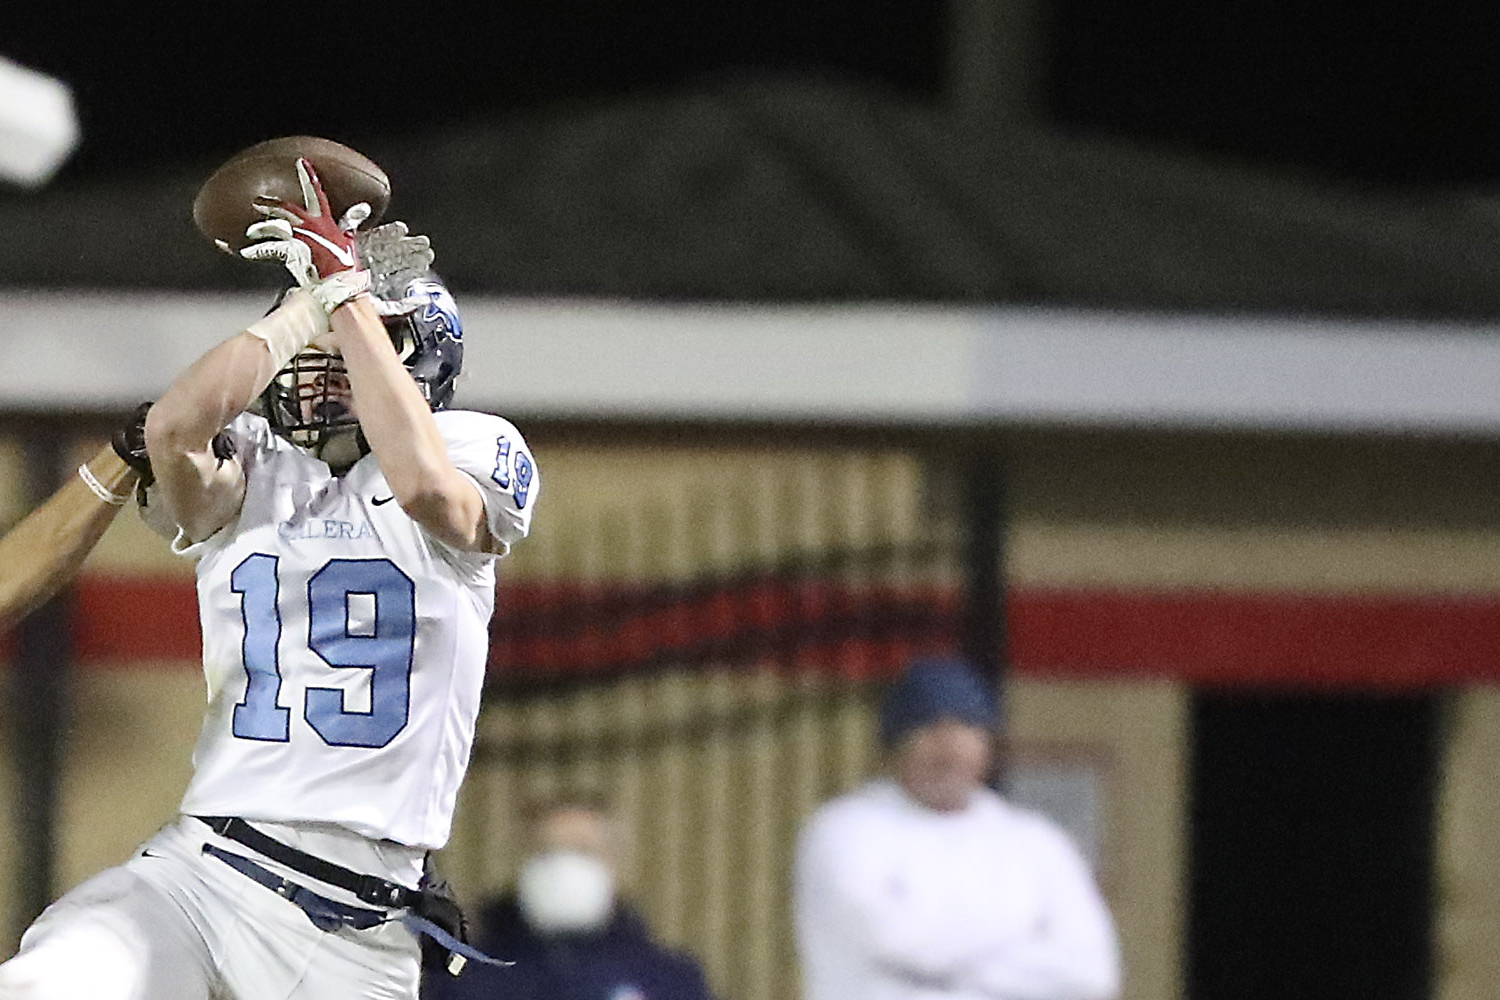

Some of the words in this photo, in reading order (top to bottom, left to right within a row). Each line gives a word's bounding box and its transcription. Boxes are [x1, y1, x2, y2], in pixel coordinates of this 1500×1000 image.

[490, 435, 533, 510] 19
[278, 519, 372, 541] CLERA
[231, 552, 415, 749] 19
